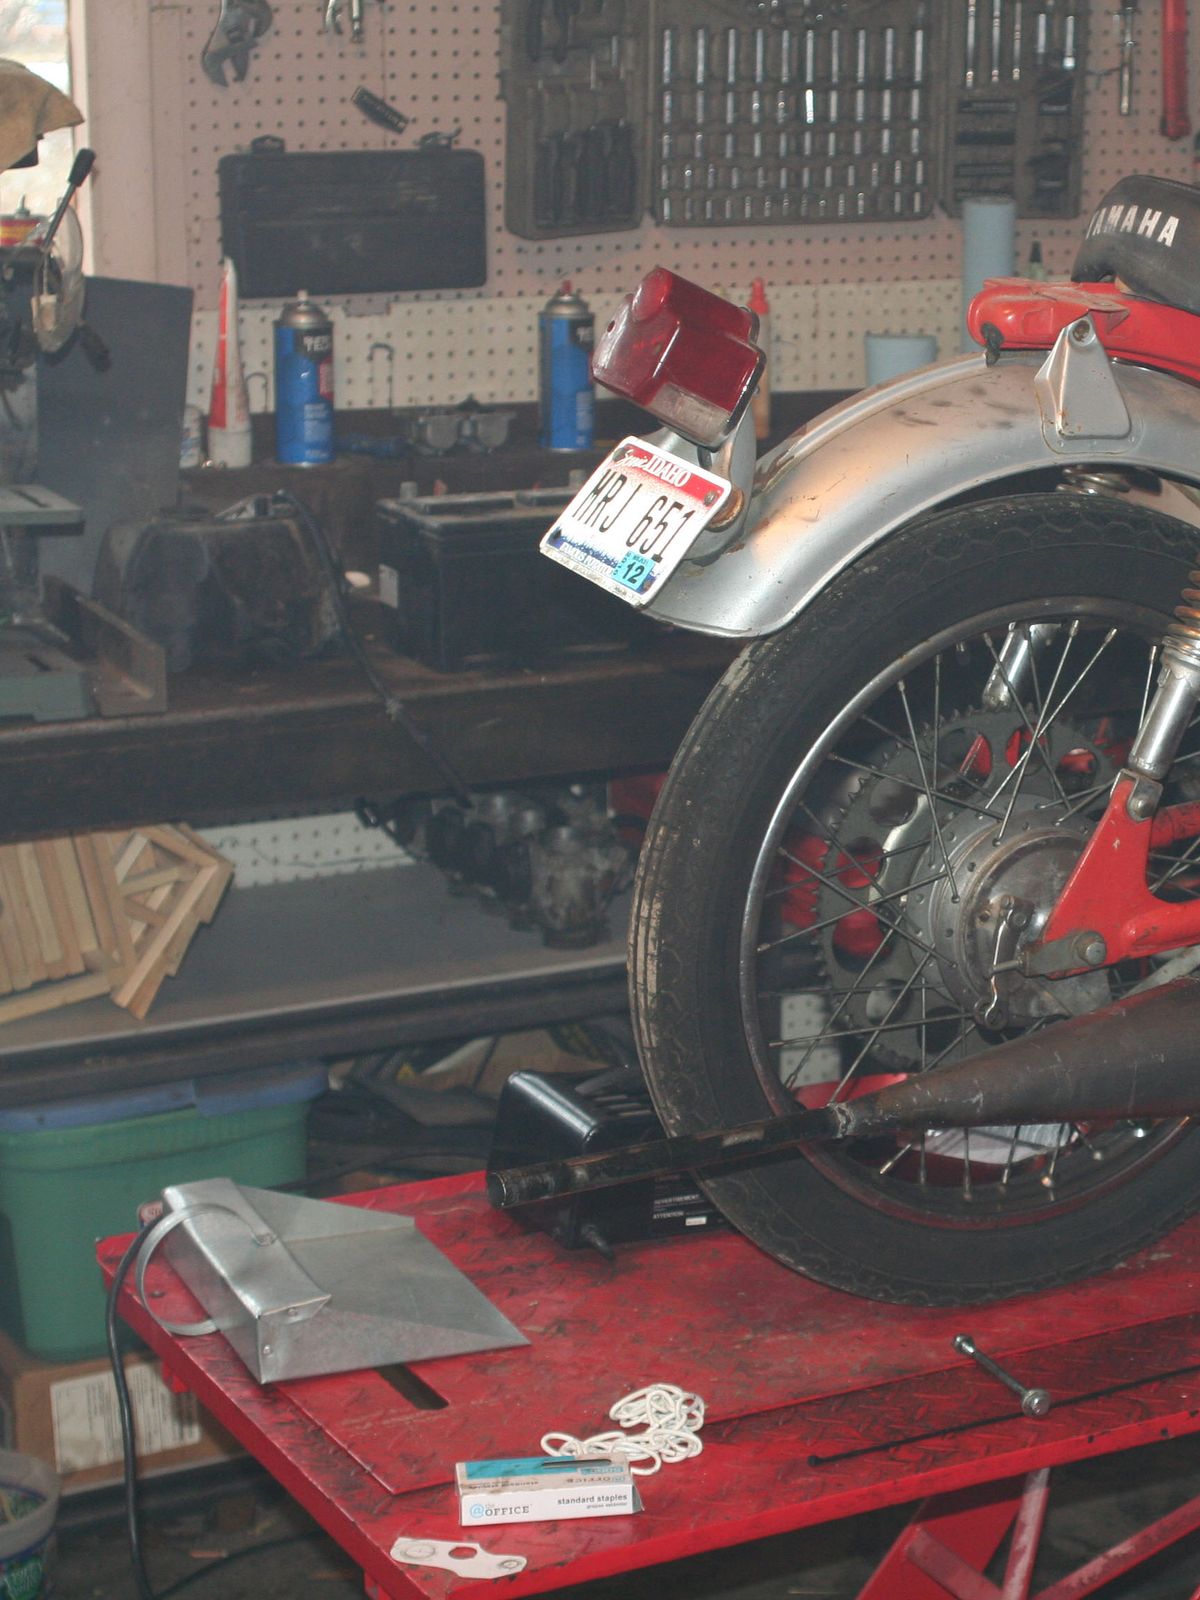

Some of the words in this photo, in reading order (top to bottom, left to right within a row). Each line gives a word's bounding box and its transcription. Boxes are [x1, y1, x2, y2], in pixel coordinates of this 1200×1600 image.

[642, 454, 692, 488] IDAHO
[626, 495, 696, 563] 651
[622, 561, 646, 584] 12
[485, 1505, 530, 1517] OFFICE
[557, 1495, 595, 1505] standard
[597, 1494, 628, 1503] staples
